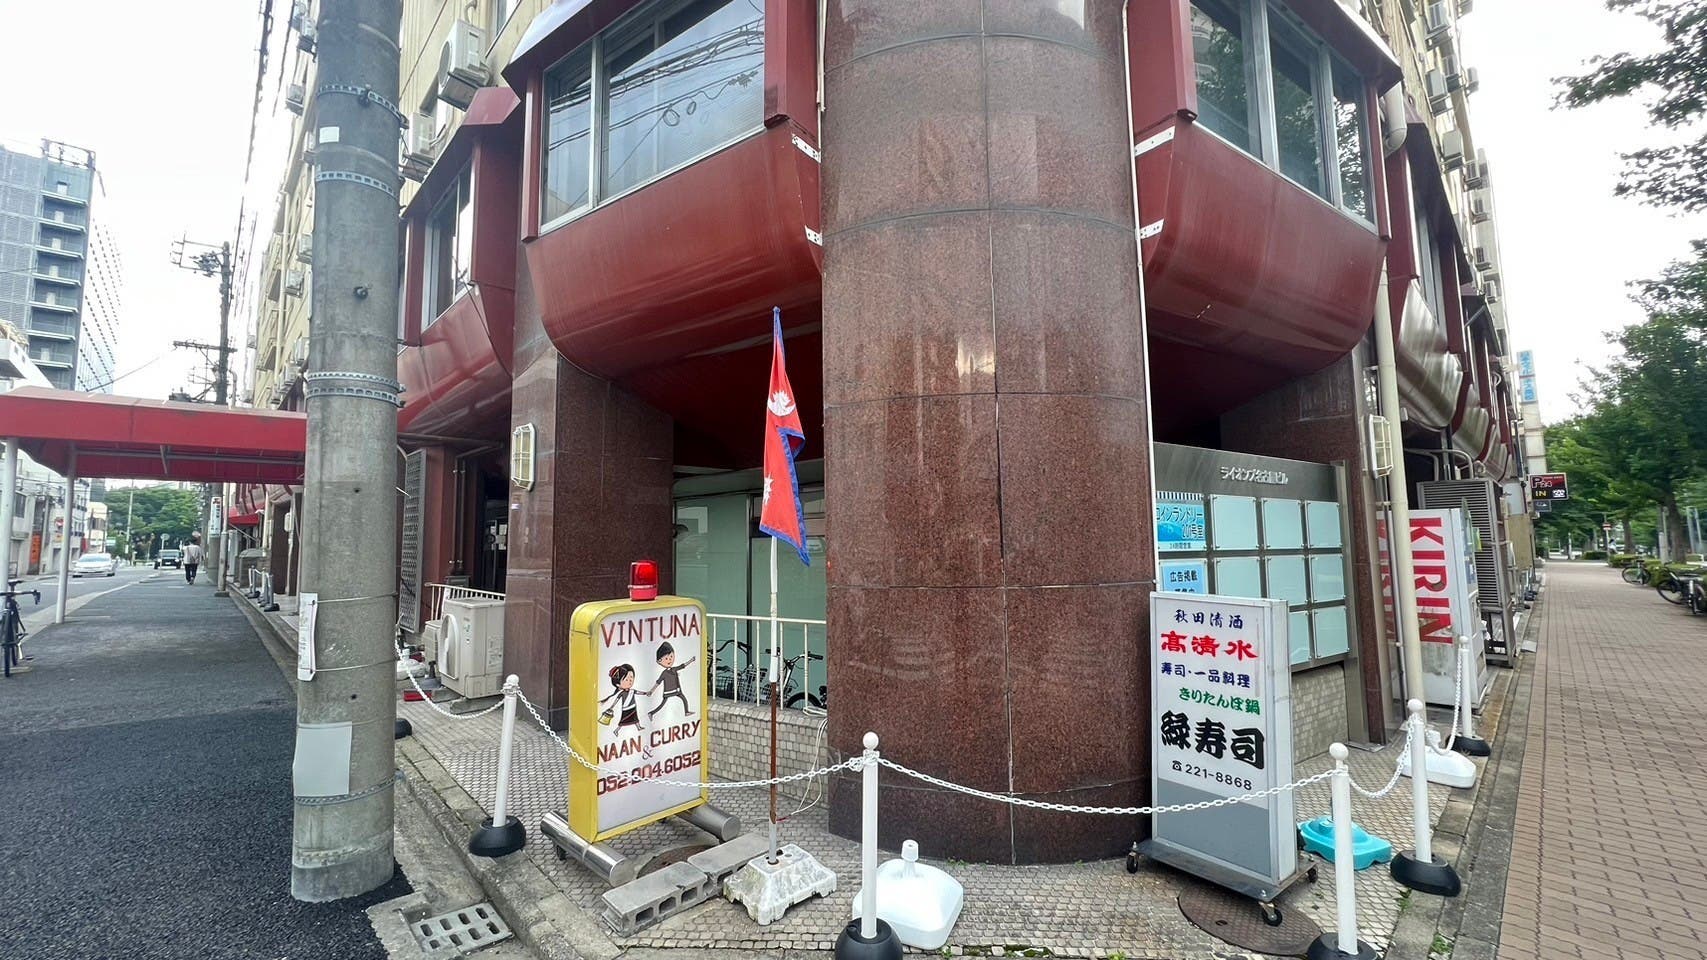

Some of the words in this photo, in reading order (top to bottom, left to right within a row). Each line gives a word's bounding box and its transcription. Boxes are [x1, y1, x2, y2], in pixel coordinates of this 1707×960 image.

[1409, 517, 1454, 645] KIRIN
[601, 613, 700, 648] VINTUNA
[1174, 609, 1244, 630] 秋田清酒
[1178, 687, 1261, 715] きりたんぽ鍋
[597, 735, 642, 765] NAAN
[642, 744, 653, 761] &
[650, 719, 701, 748] CURRY
[1160, 710, 1265, 770] 緑寿司
[1185, 764, 1253, 791] 221-8868
